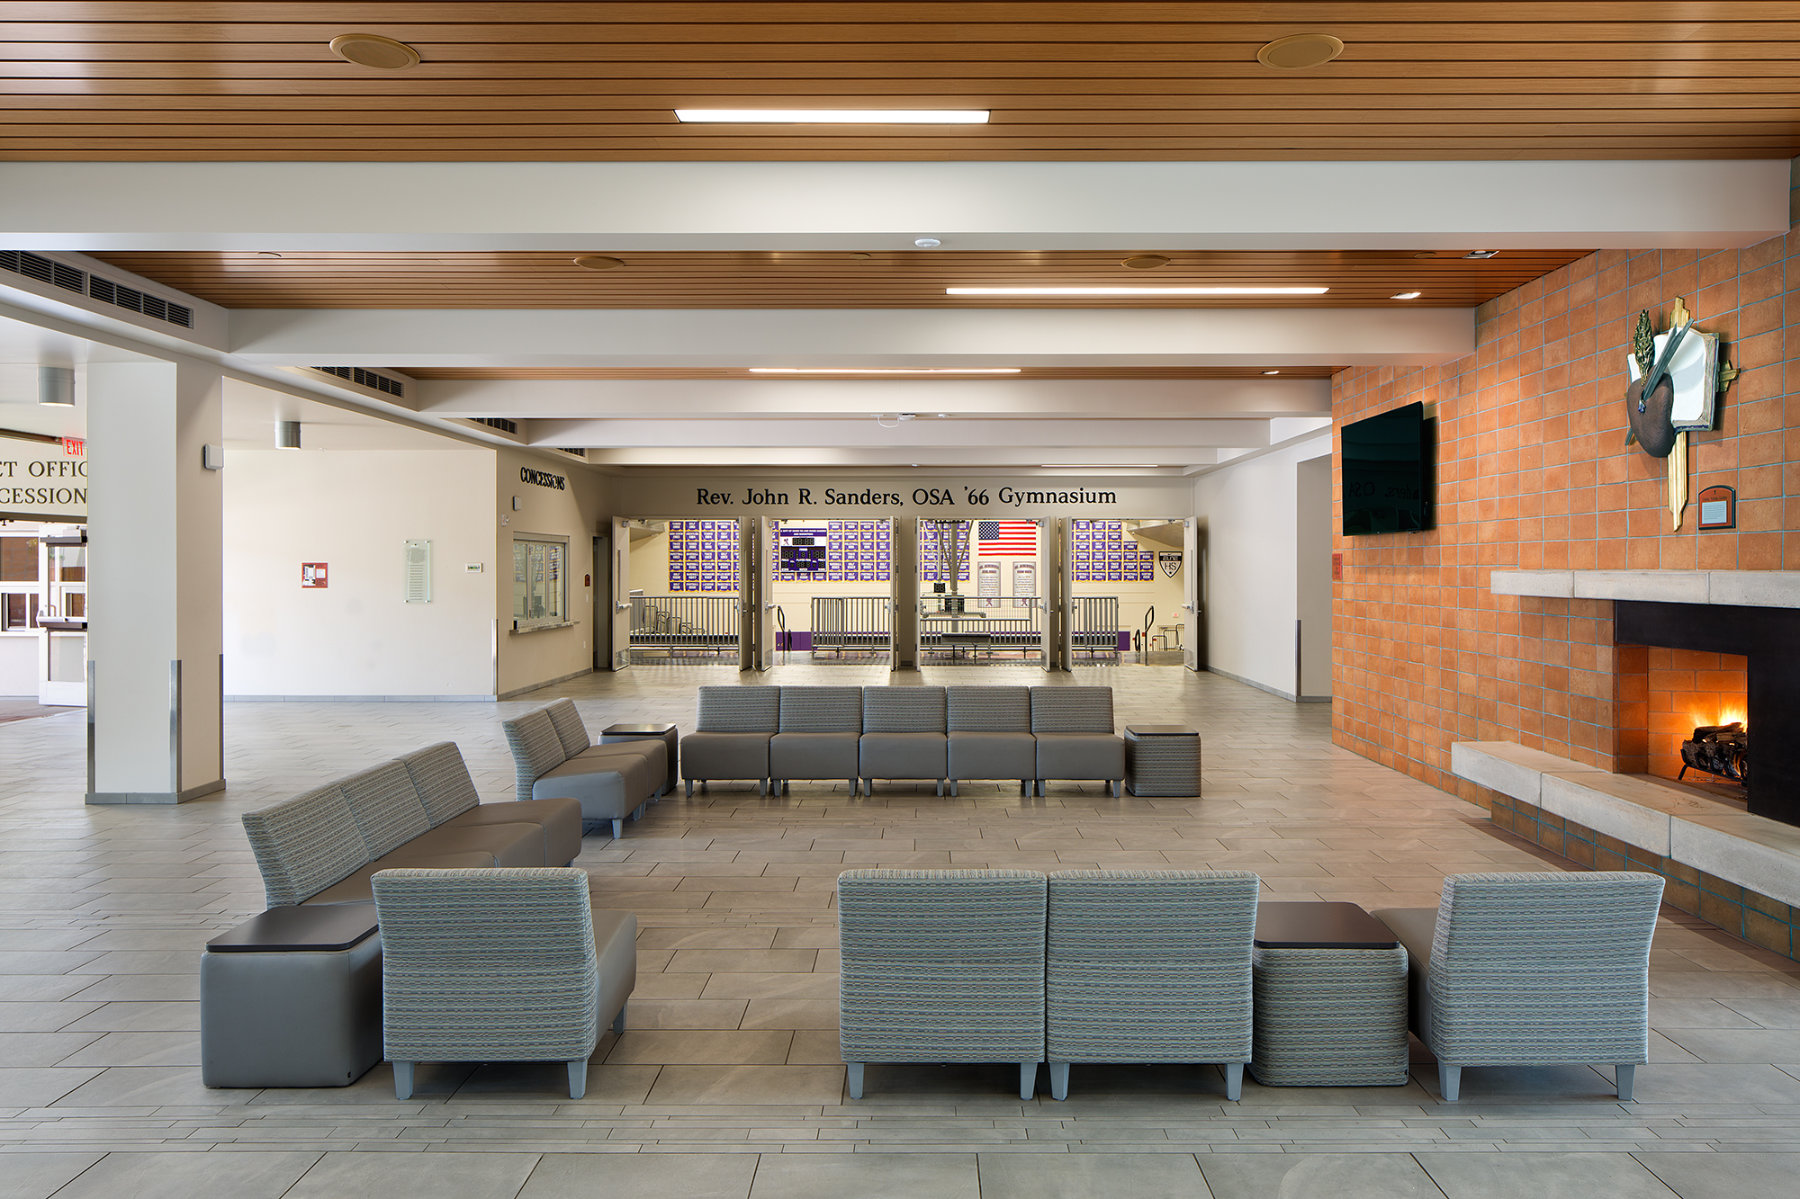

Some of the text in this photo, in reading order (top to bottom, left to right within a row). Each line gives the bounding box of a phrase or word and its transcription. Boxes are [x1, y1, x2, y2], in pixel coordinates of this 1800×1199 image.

[66, 439, 84, 456] EXIT
[520, 466, 566, 491] CONCESSIONS
[697, 486, 1117, 508] Rev. John R. Sanders, OSA '66 Gymnasium
